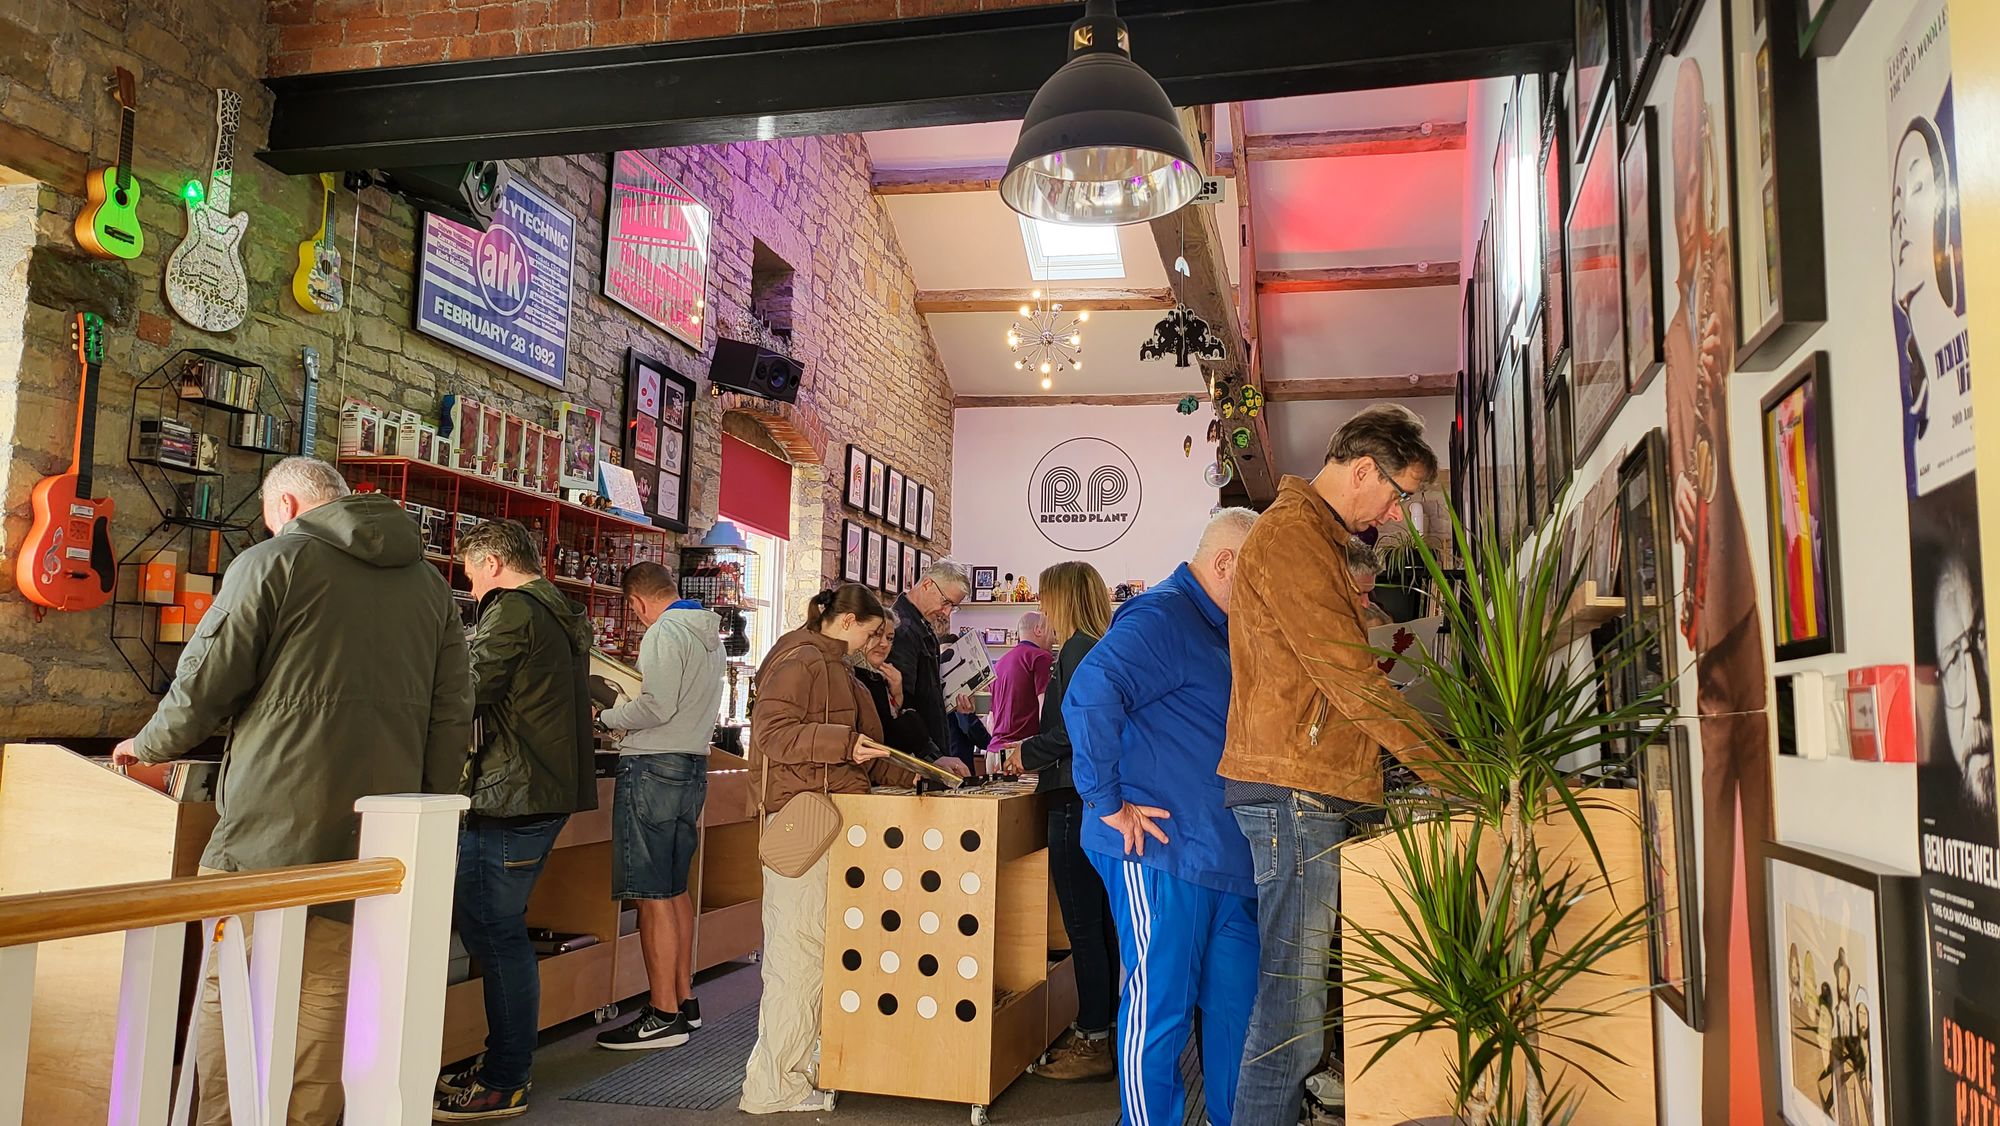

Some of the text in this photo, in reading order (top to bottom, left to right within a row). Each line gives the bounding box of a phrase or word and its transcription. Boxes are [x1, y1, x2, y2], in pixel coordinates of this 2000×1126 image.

[498, 194, 569, 252] LYTECHNIC
[482, 242, 522, 302] ark
[434, 296, 509, 346] FEBRUARY
[511, 334, 526, 354] 28
[528, 342, 556, 368] 1992
[1040, 513, 1128, 523] RECORD PLANT
[1924, 833, 1945, 874] BEN
[1931, 902, 1943, 919] THE
[1943, 905, 1954, 923] OLD
[1943, 1015, 1996, 1101] EDDIE
